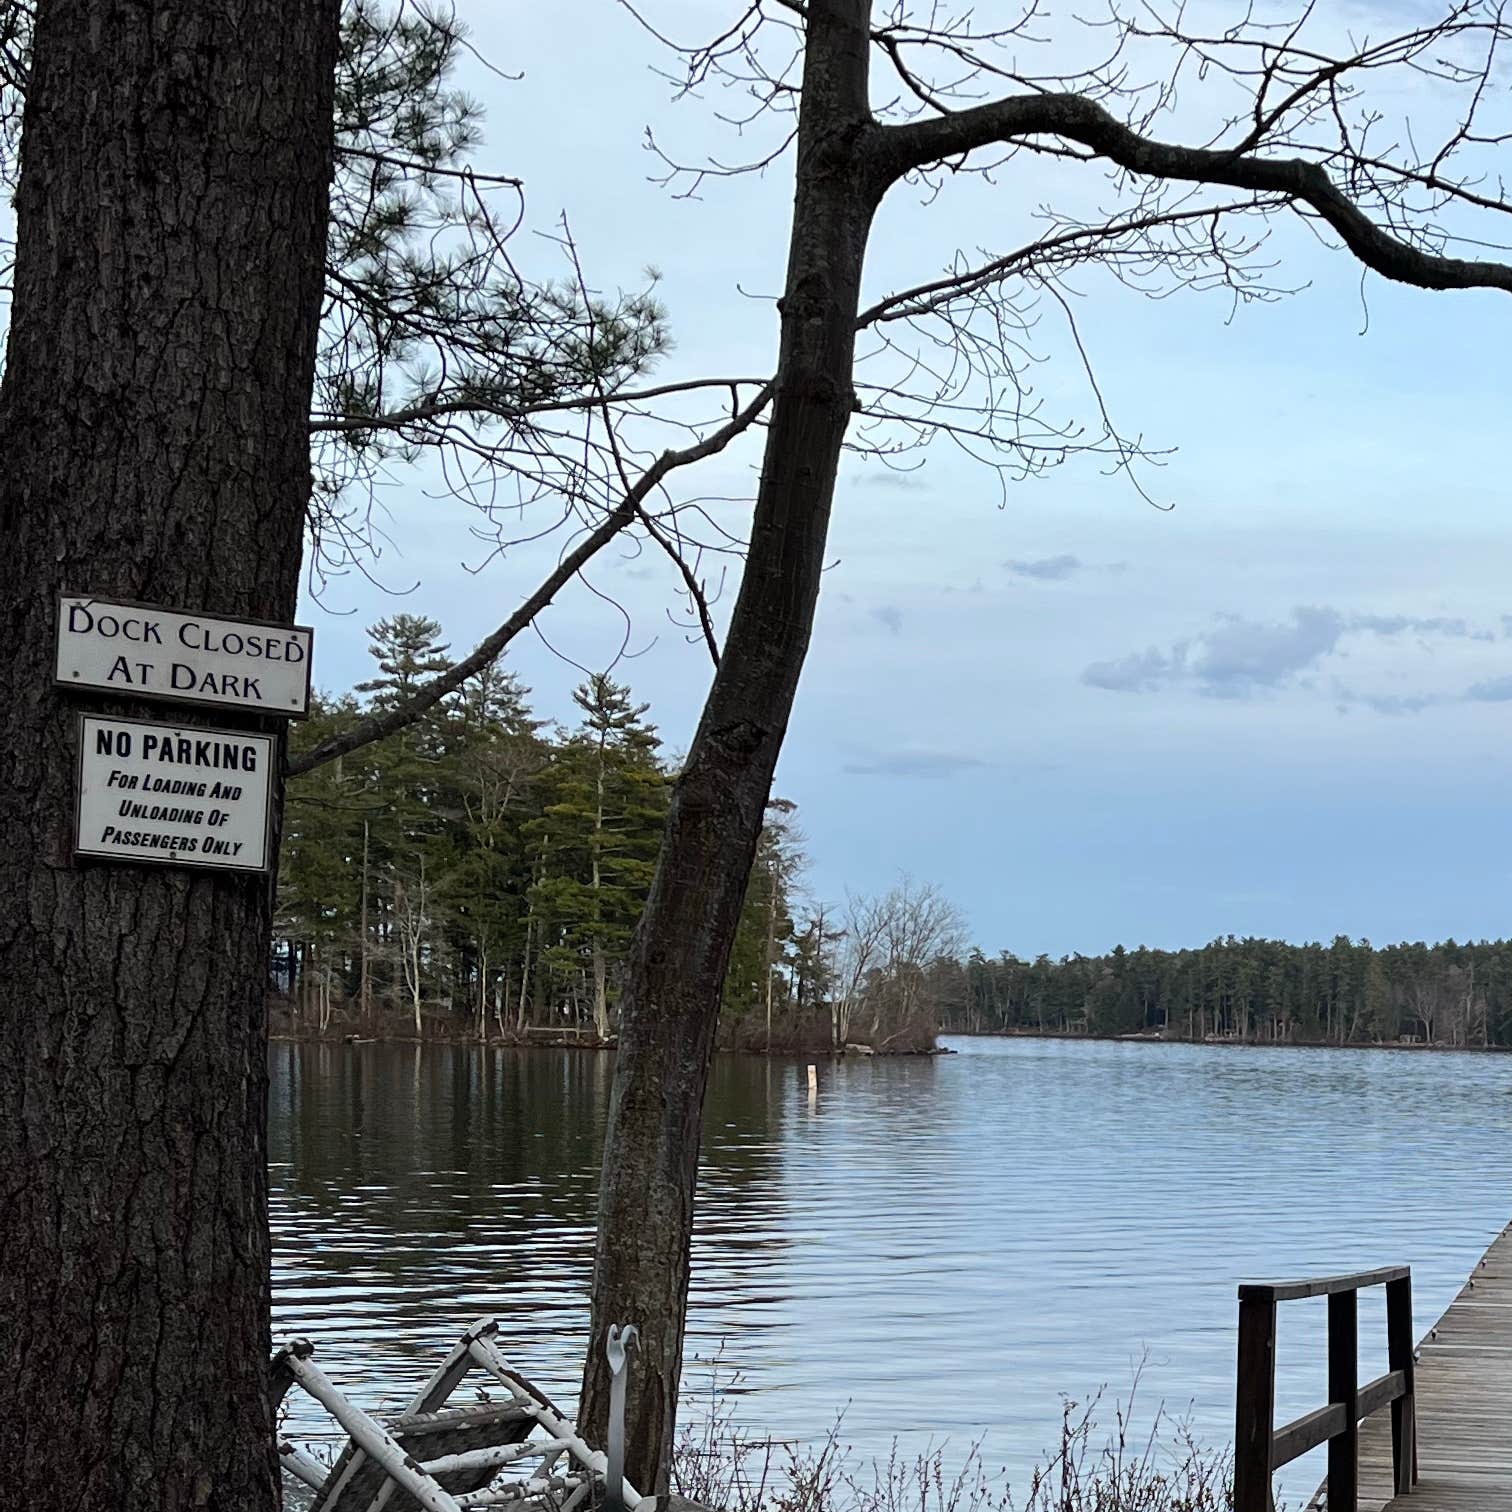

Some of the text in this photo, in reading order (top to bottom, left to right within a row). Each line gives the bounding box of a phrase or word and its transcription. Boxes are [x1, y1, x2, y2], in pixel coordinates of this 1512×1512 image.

[69, 606, 304, 662] DOCK CLOSED
[107, 656, 262, 699] AT DARK
[97, 729, 256, 772] NO PARKING
[107, 771, 242, 800] FOR LOADING AND
[119, 801, 230, 826] UNLOADING OF
[102, 827, 242, 856] PASSENGERS ONLY
